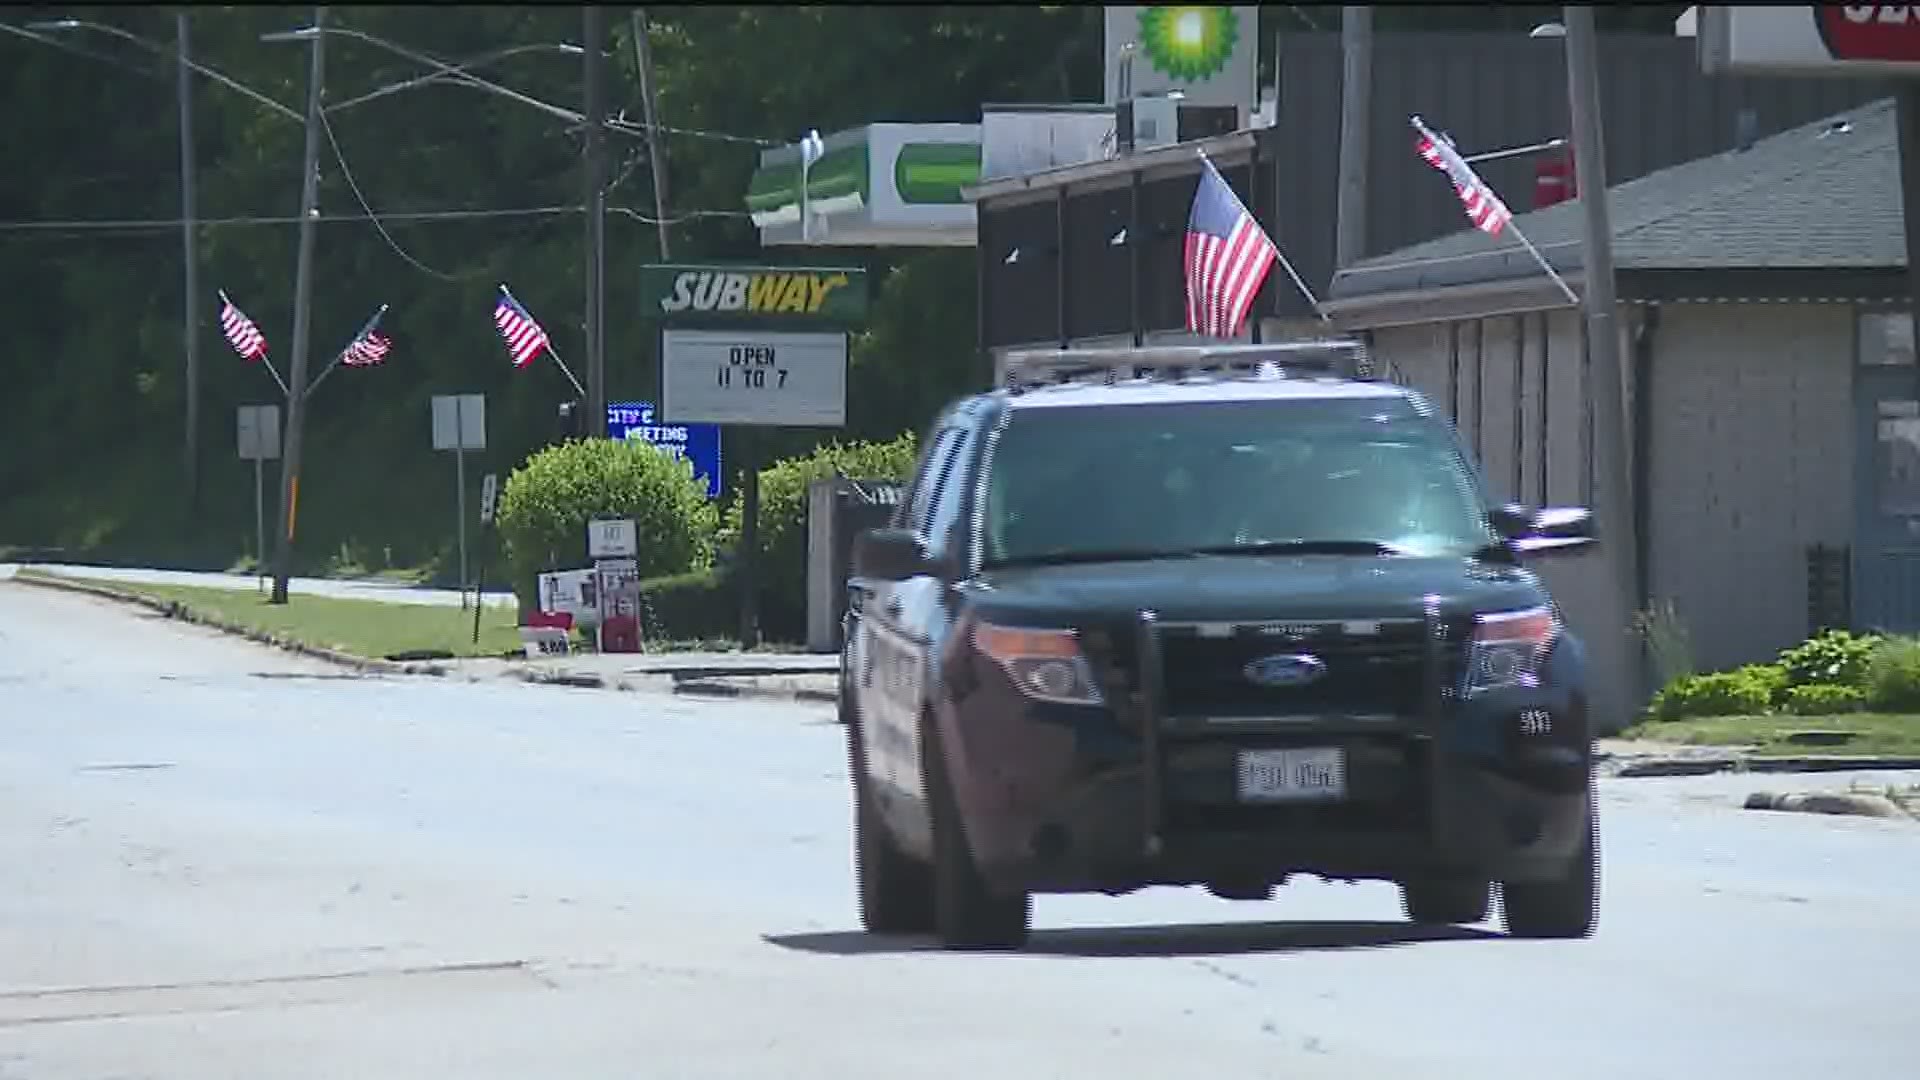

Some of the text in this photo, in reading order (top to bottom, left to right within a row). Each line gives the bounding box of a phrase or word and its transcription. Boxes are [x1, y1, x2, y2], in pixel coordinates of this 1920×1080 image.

[661, 271, 848, 313] SUBWAY
[730, 347, 775, 366] OPEN
[718, 367, 789, 388] 11 TO 7
